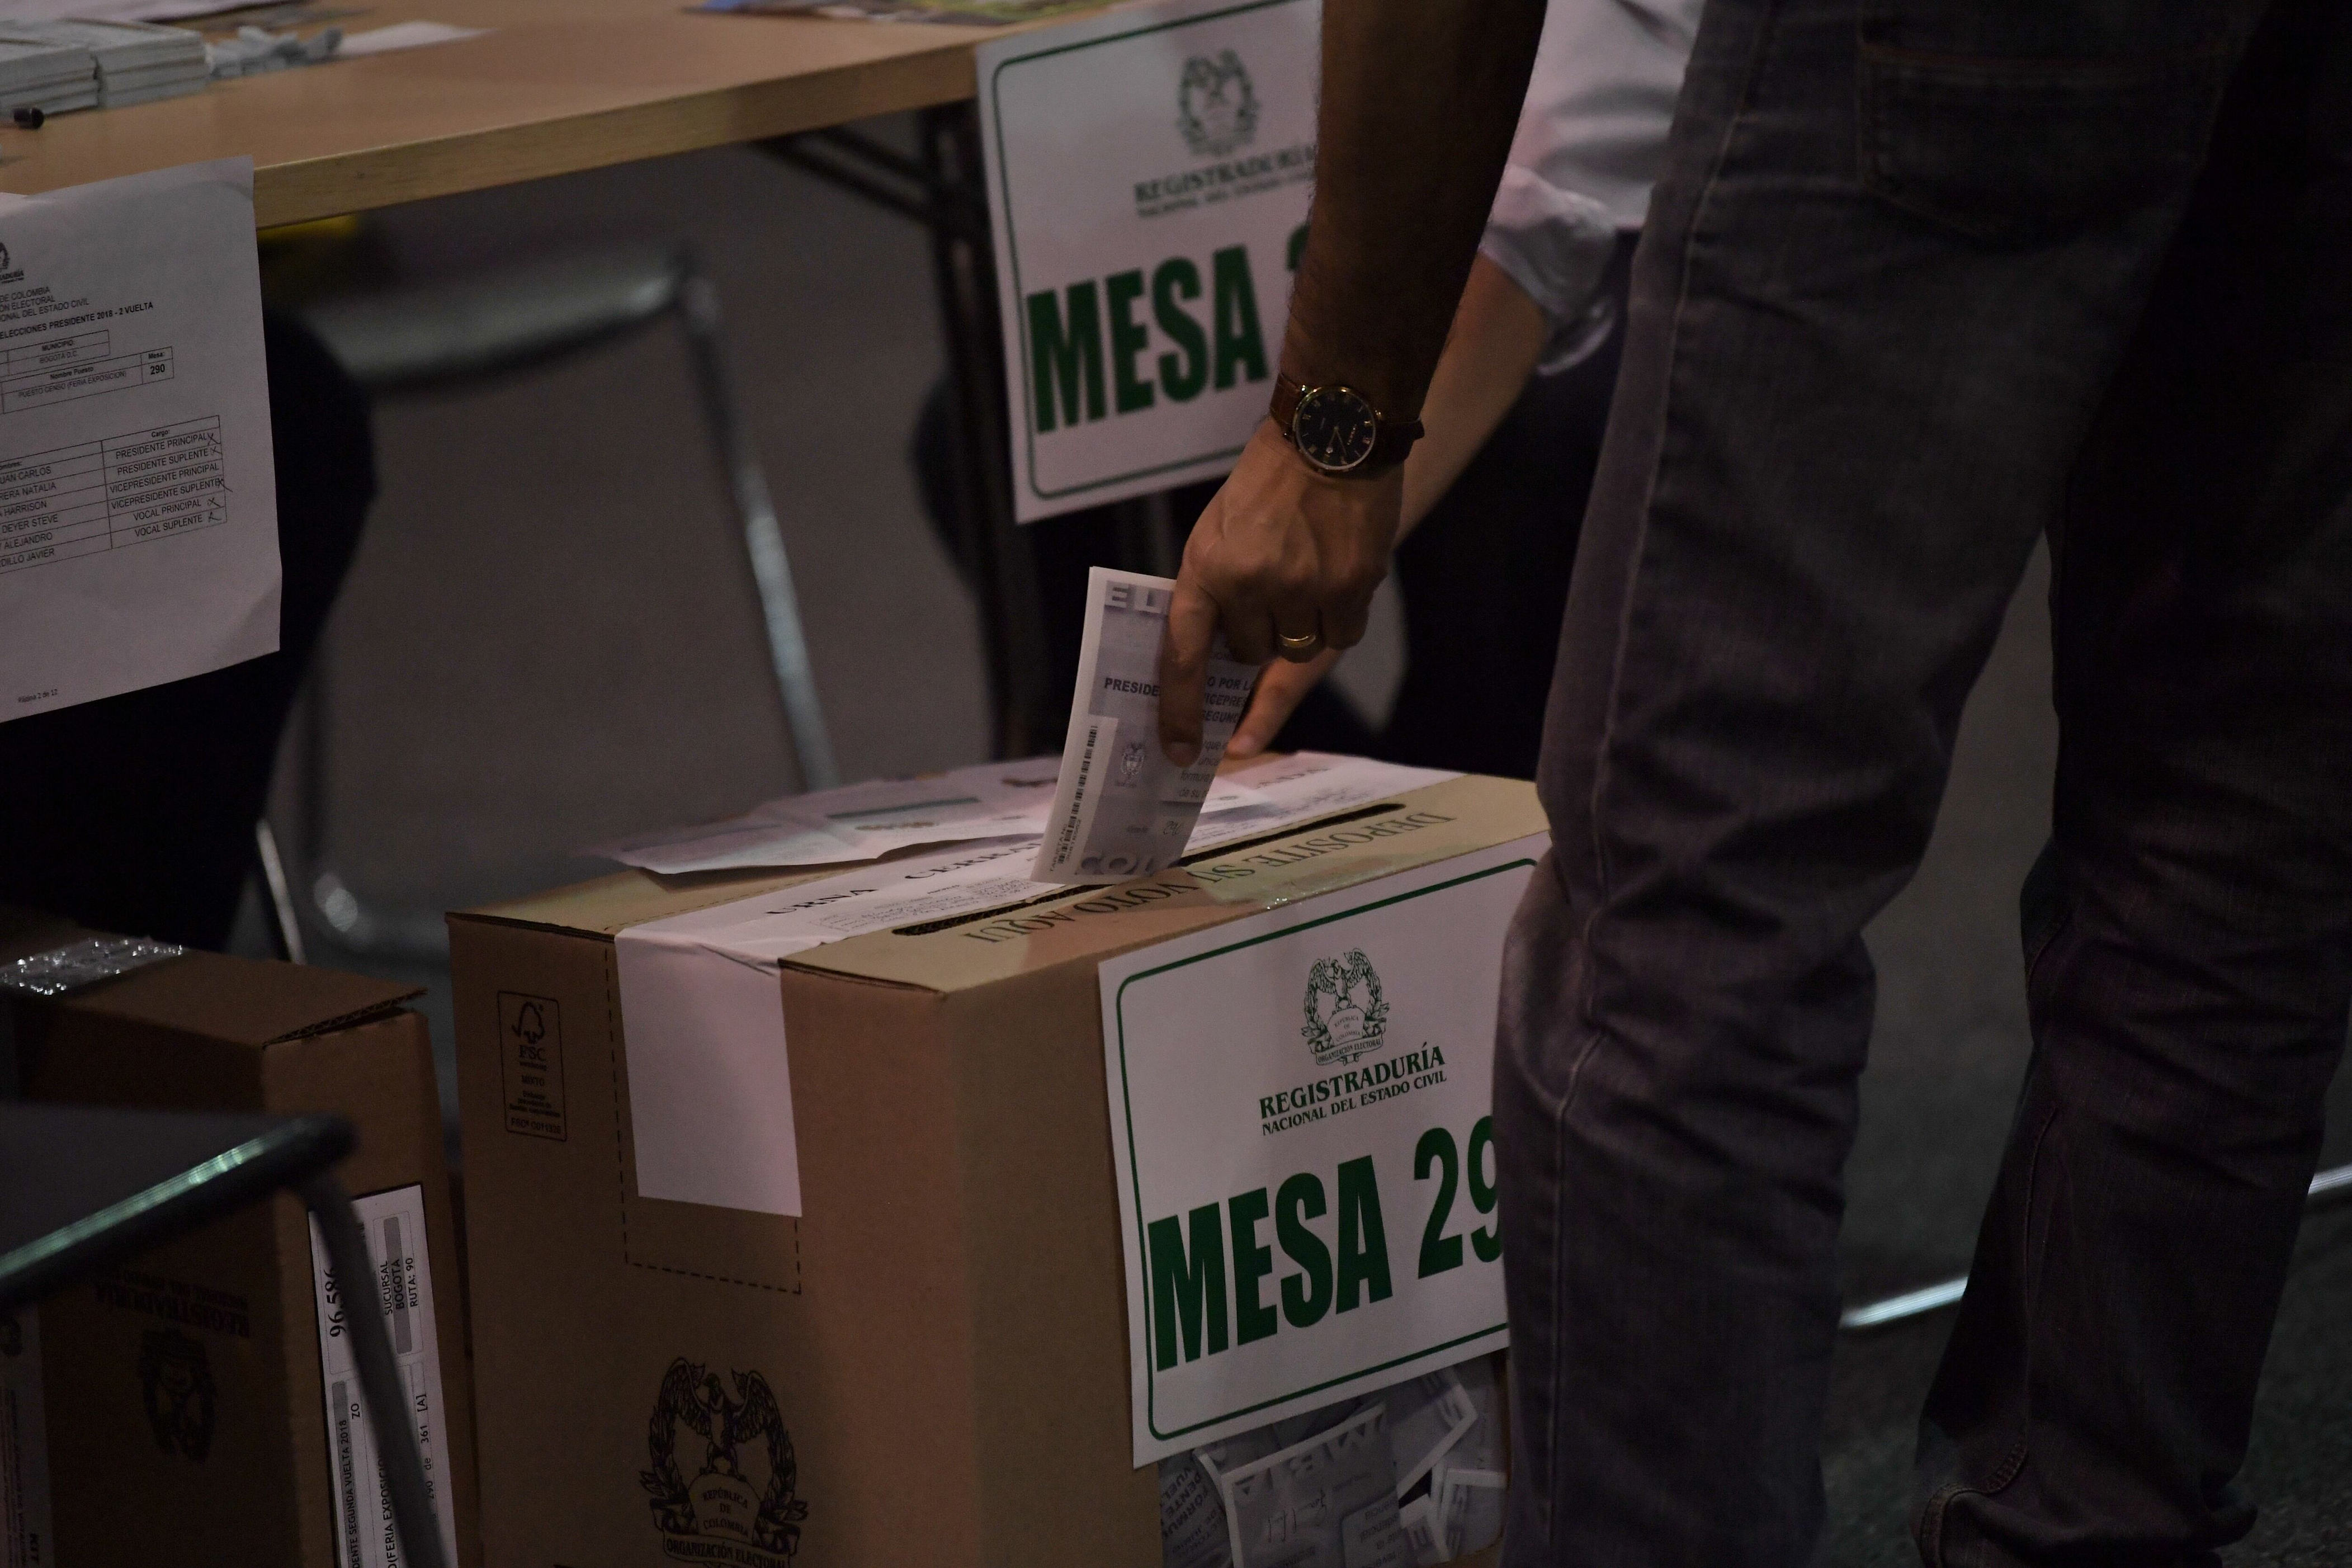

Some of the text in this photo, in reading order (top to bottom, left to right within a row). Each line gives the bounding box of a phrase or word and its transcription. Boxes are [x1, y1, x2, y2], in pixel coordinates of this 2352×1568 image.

[12, 295, 55, 310] ELECTORAL
[39, 302, 69, 314] ESTADO
[49, 314, 95, 329] PRESIDENTE
[97, 310, 113, 319] 2018
[124, 302, 154, 314] VUELTA
[1027, 246, 1269, 434] MESA
[50, 370, 72, 380] Nombre
[150, 363, 166, 375] 290
[116, 433, 206, 459] PRESIDENTE PRINCIPAL
[117, 448, 208, 475] PRESIDENTE SUPLENTE
[18, 466, 51, 480] CARLOS
[110, 462, 219, 493] VICEPRESIDENTE PRINCIPAL
[22, 482, 56, 495] NATALIA
[111, 488, 178, 509] VICEPRESIDENTE
[4, 500, 47, 517] HARRISON
[133, 499, 201, 521] VOCAL PRINCIPAL
[32, 514, 58, 527] STEVE
[135, 514, 203, 537] VOCAL SUPLENTE
[4, 532, 53, 550] ALEJANDRO
[28, 548, 54, 561] JAVIER
[1219, 677, 1241, 689] POR
[1241, 813, 1457, 867] DEPOSITE
[1187, 865, 1255, 883] SU
[765, 889, 879, 914] URNA
[1073, 882, 1200, 913] VOTO
[519, 1044, 546, 1061] FSC
[1318, 1045, 1353, 1062] ORGANIZACIÓN
[1354, 1038, 1381, 1050] ELECTORAL
[1259, 1041, 1446, 1120] REGISTRADURÍA
[1262, 1071, 1447, 1136] NACIONAL DEL ESTADO CIVIL
[1148, 1155, 1393, 1372] MESA
[380, 1260, 393, 1315] SUCURSAL
[392, 1259, 405, 1310] BOGOTA
[406, 1258, 418, 1307] RUTA: 90
[415, 1394, 428, 1413] [A]
[339, 1419, 349, 1445] 2018
[419, 1425, 429, 1443] 361
[341, 1446, 352, 1487] VUELTA
[424, 1457, 432, 1471] de
[346, 1488, 357, 1535] SEGUNDA
[720, 1503, 730, 1514] DE
[703, 1517, 748, 1537] COLOMBIA
[666, 1538, 734, 1560] ORGANIZACIÓN
